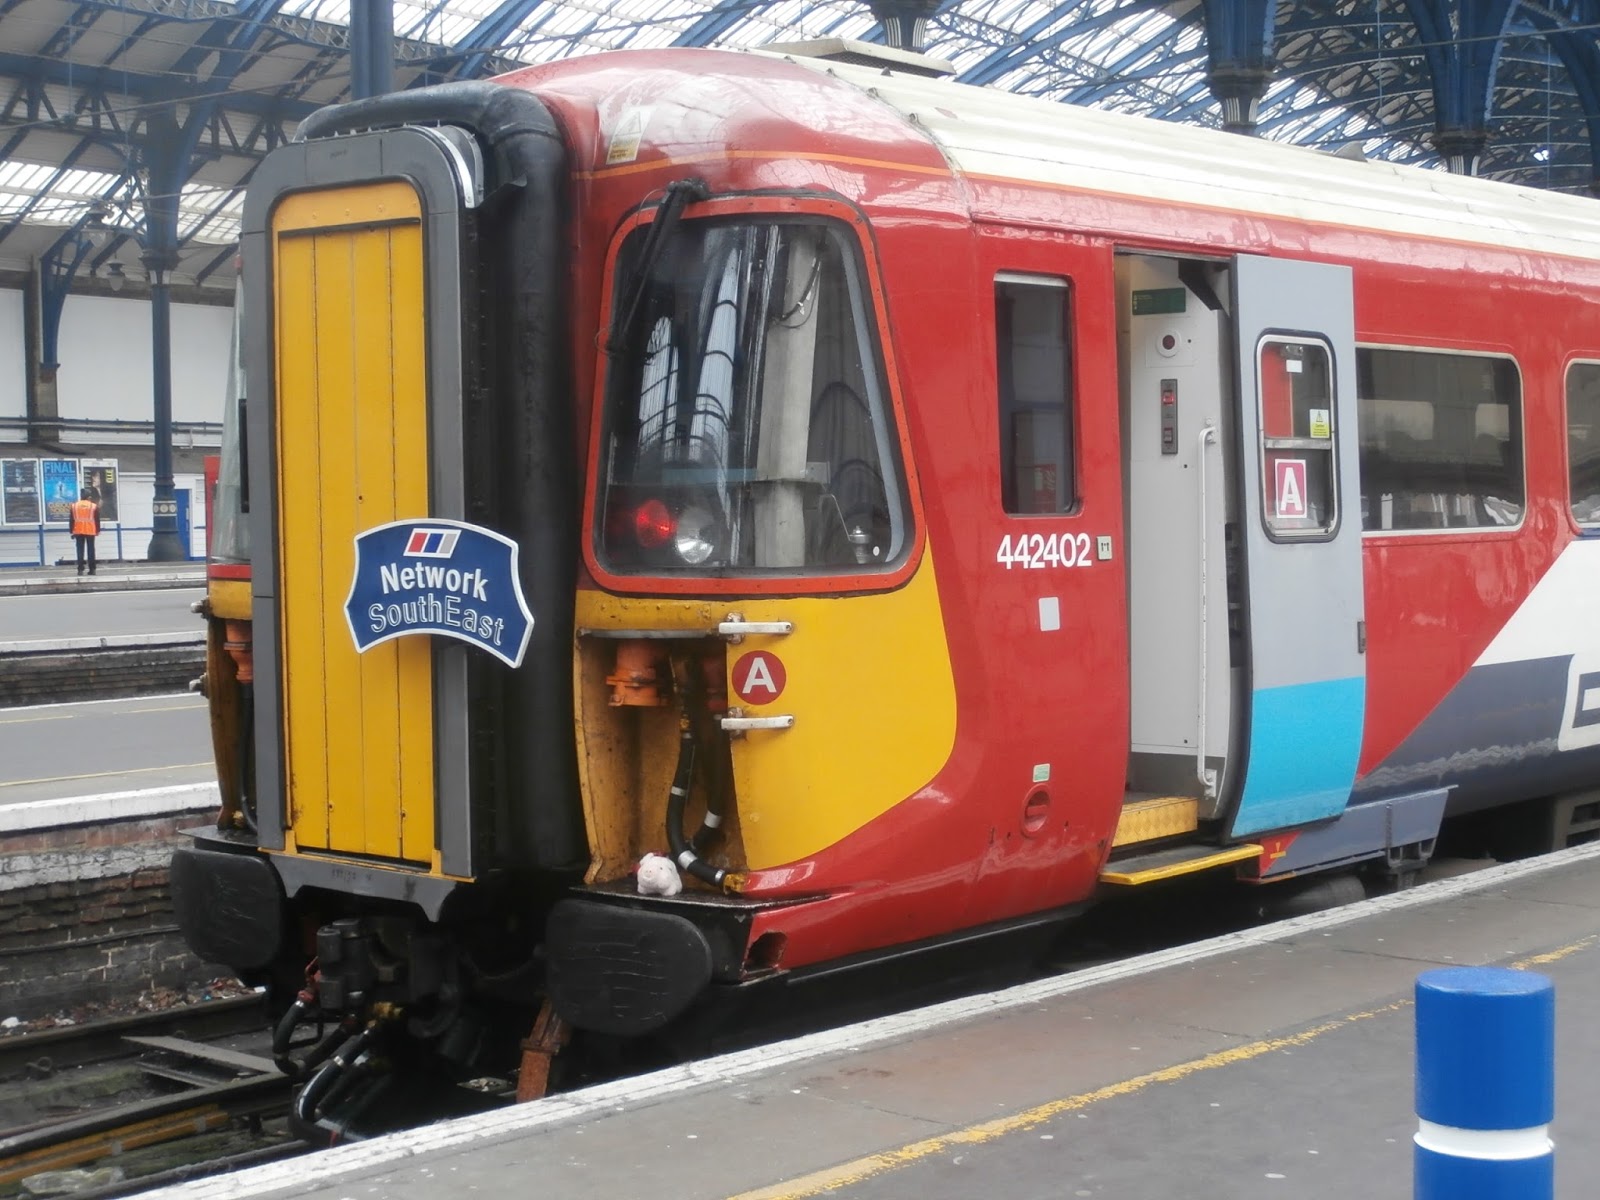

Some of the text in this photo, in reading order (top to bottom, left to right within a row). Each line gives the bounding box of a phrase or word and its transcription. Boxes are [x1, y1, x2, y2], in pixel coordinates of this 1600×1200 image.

[1280, 467, 1303, 512] A
[996, 533, 1093, 570] 442402
[380, 562, 489, 602] Network
[368, 593, 505, 646] SouthEast
[742, 657, 777, 694] A
